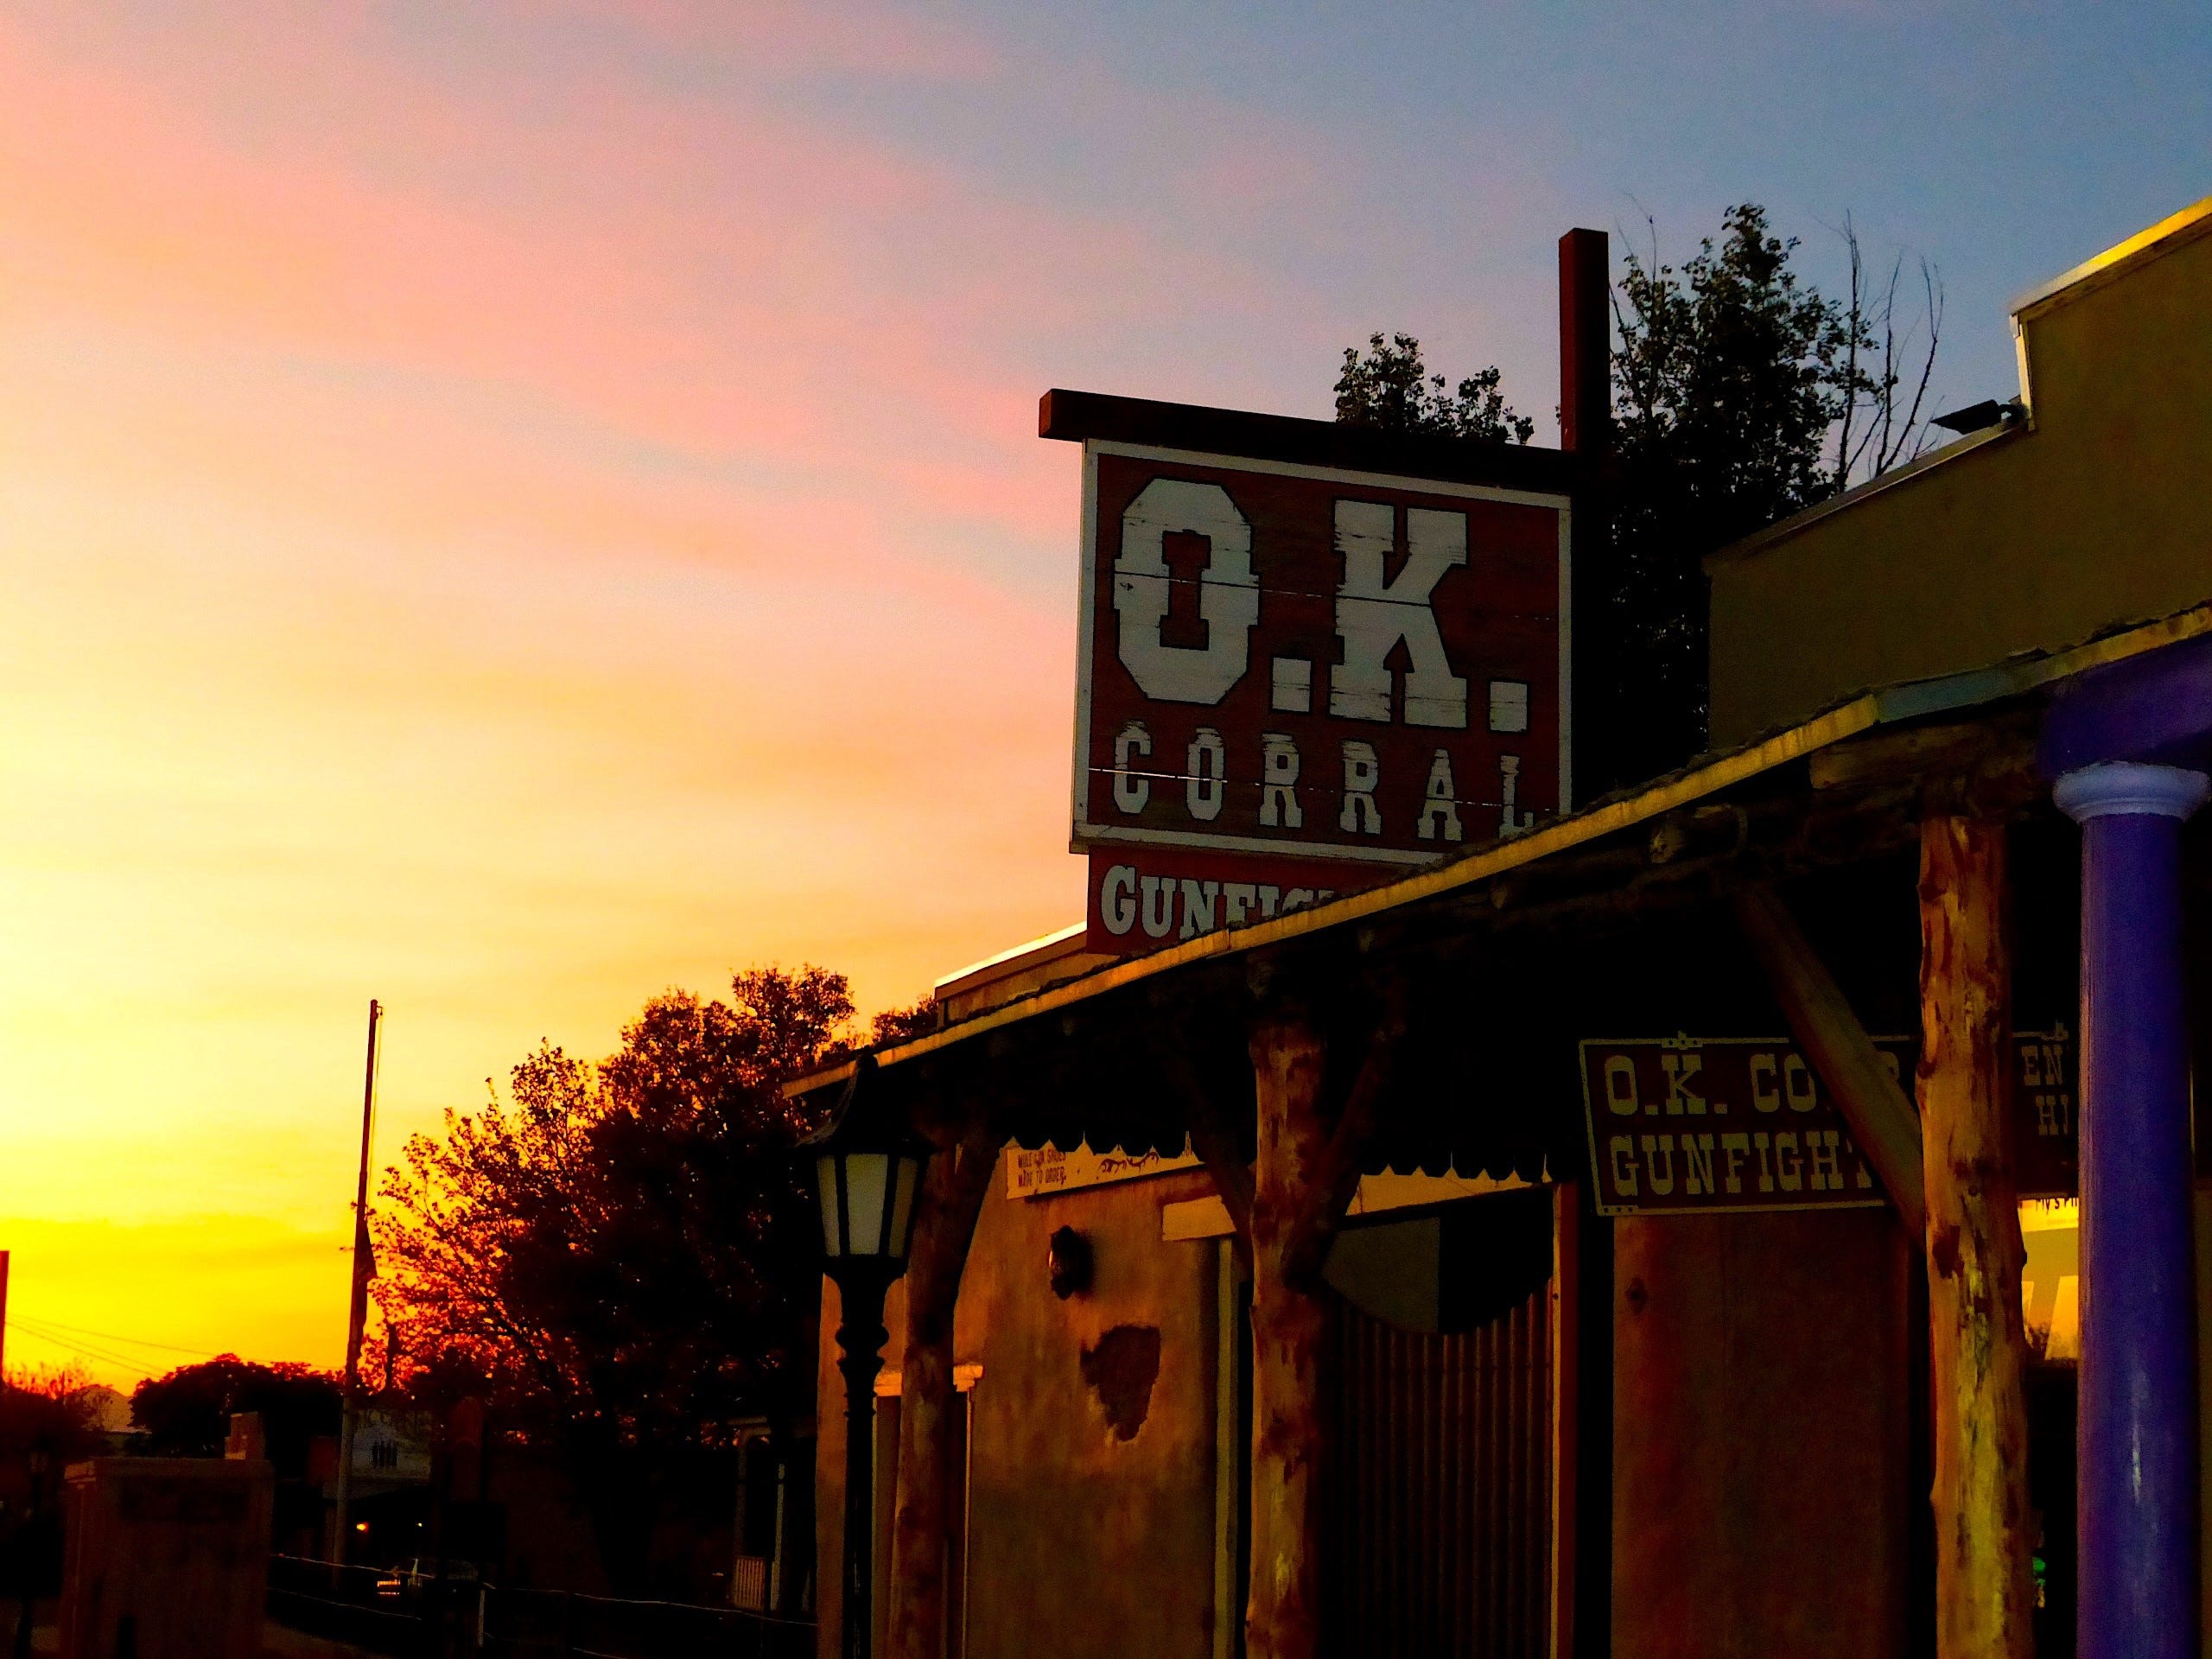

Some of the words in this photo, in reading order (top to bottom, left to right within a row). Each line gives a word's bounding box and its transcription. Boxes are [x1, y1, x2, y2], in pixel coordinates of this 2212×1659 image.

[1114, 477, 1529, 733] O.K.
[1113, 720, 1534, 842] CORRAL
[1604, 1053, 1729, 1116] O.K.
